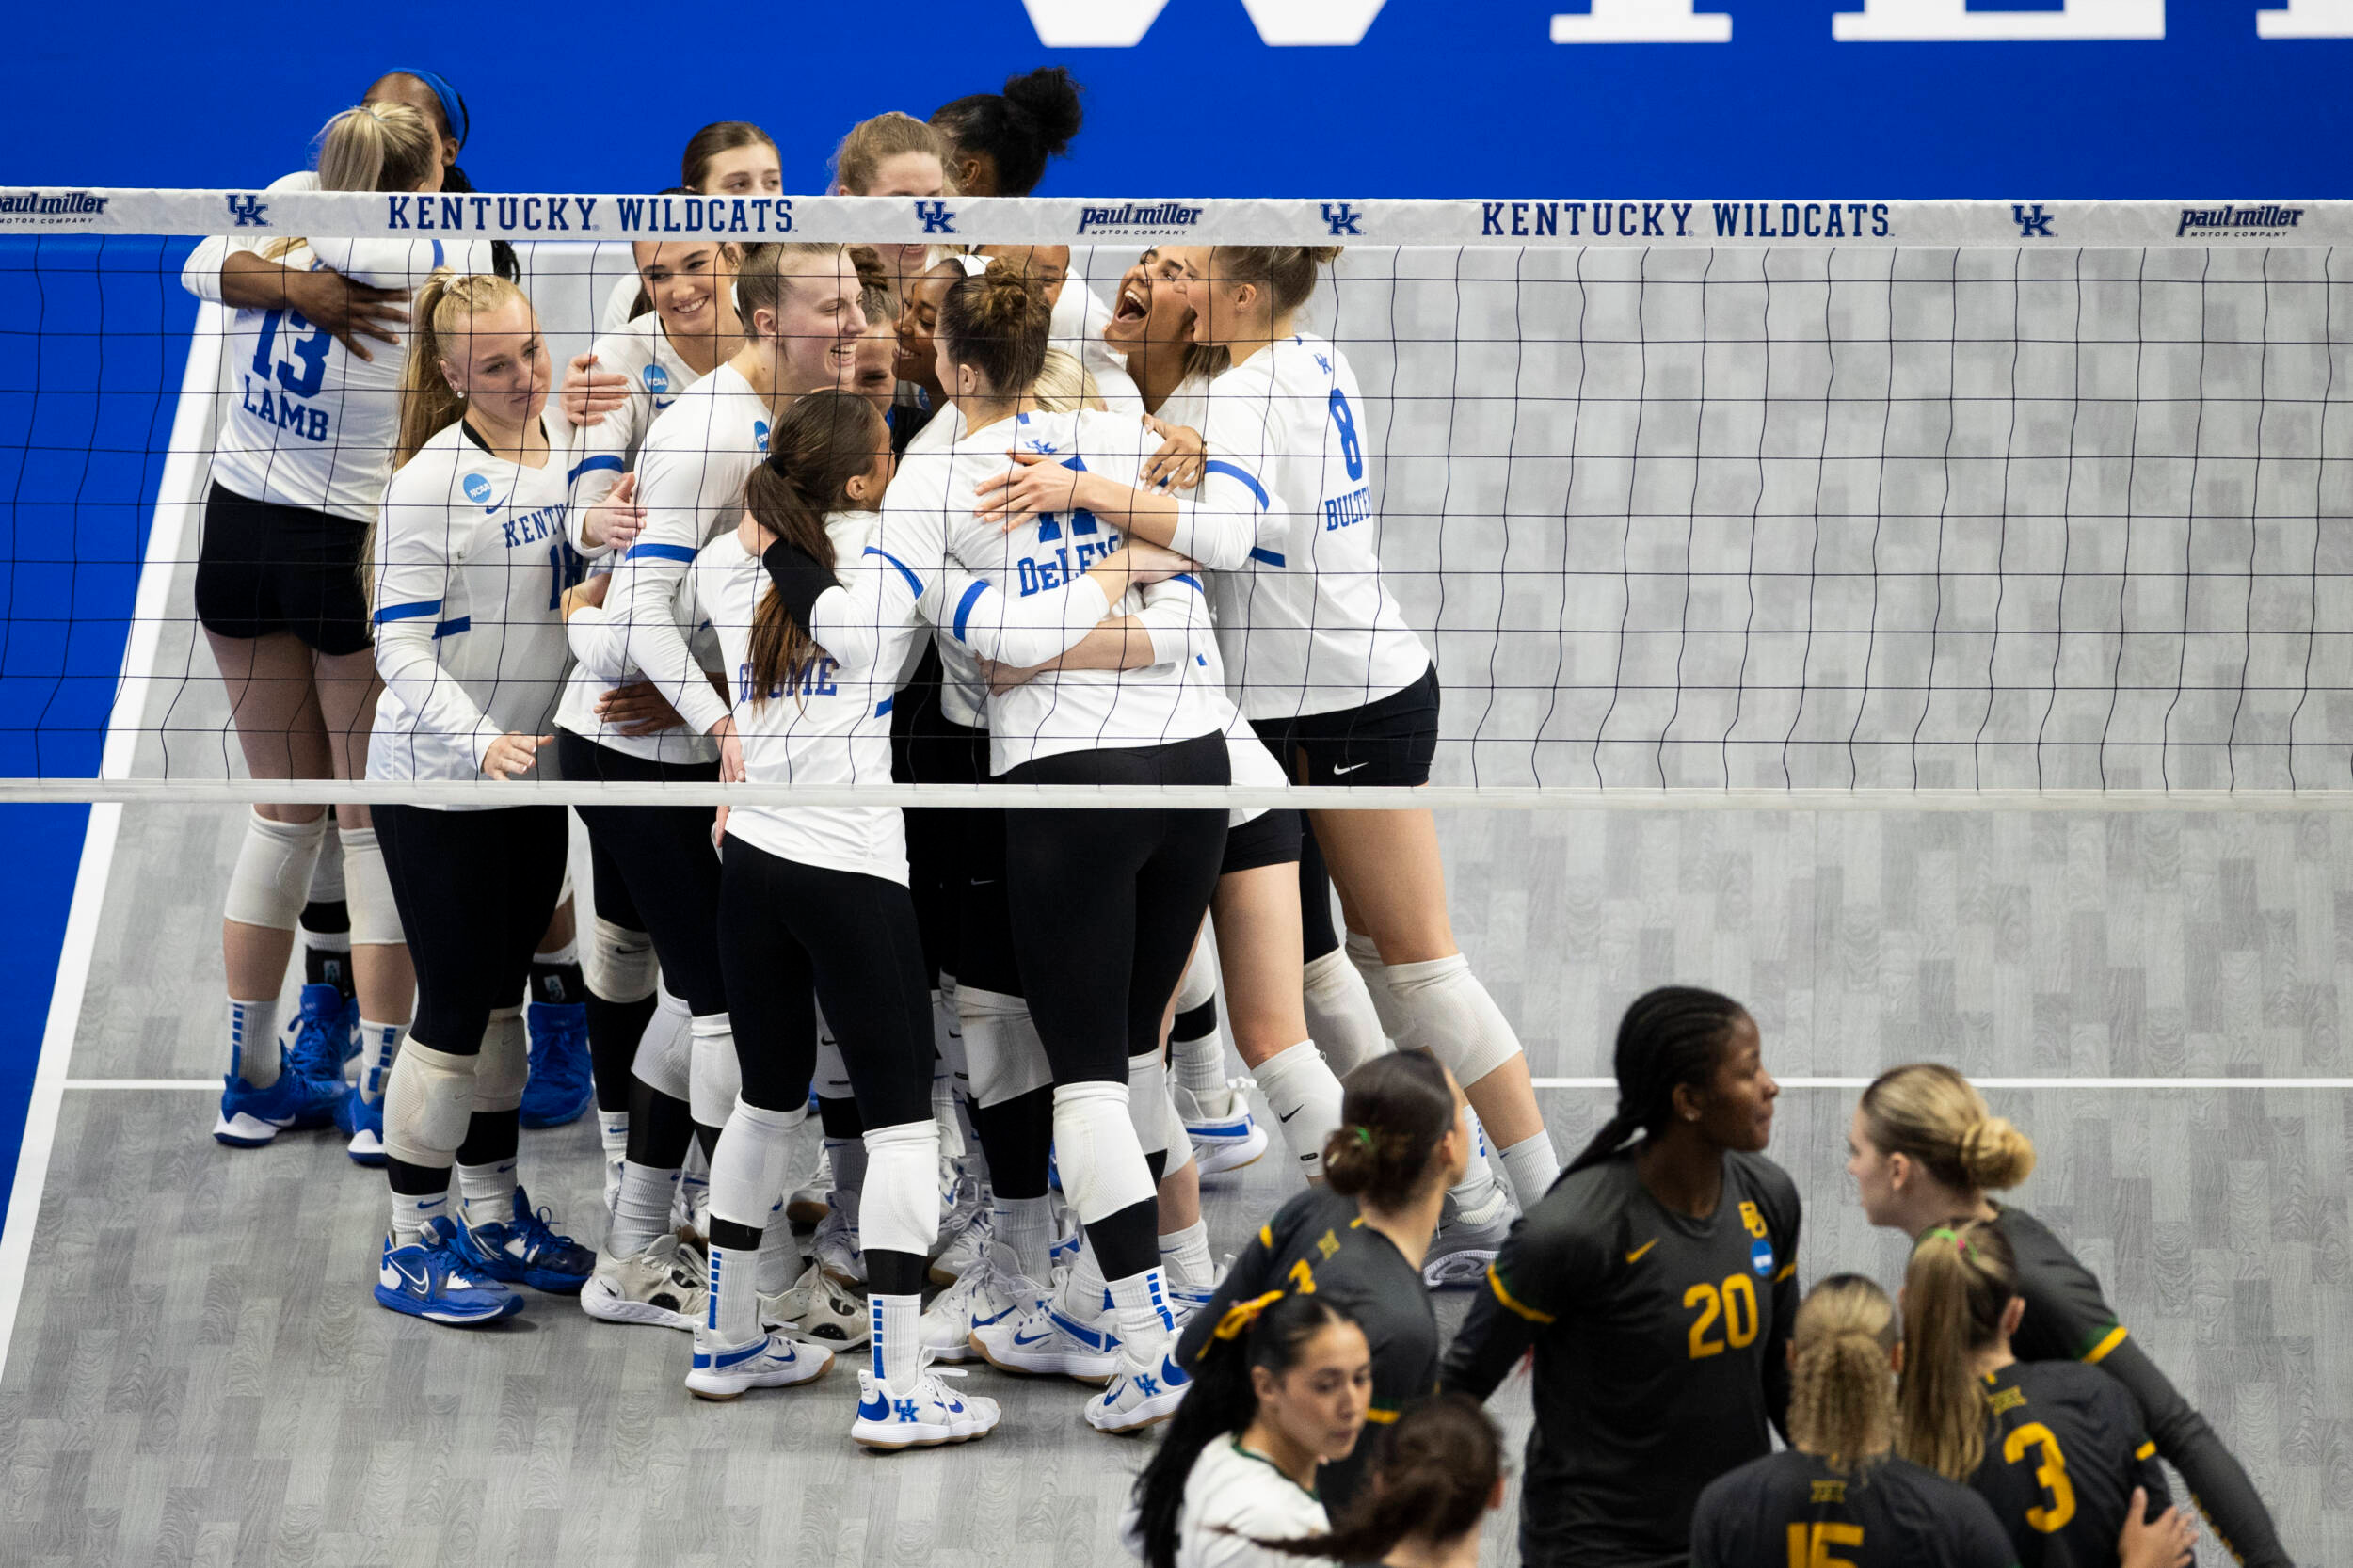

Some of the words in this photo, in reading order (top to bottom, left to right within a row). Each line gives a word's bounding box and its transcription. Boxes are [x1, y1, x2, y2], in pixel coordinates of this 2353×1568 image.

[0, 191, 39, 215] aul
[40, 191, 109, 215] miller
[226, 193, 269, 227] UK
[388, 195, 597, 232] KENTUCKY
[616, 198, 792, 232] WILDCATS
[914, 200, 956, 233] UK
[1077, 203, 1131, 234] paul
[1132, 203, 1203, 225] miller
[1320, 202, 1362, 235] UK
[1481, 202, 1692, 236] KENTUCKY
[1712, 203, 1889, 237] WILDCATS
[2011, 203, 2055, 237] UK
[2175, 204, 2232, 237] paul
[2233, 204, 2304, 227] miller
[252, 309, 331, 399] 13
[243, 374, 328, 442] LAMB
[1328, 388, 1363, 482] 8
[470, 484, 491, 499] NCAA
[1683, 1273, 1758, 1359] 20
[2003, 1421, 2076, 1533] 3
